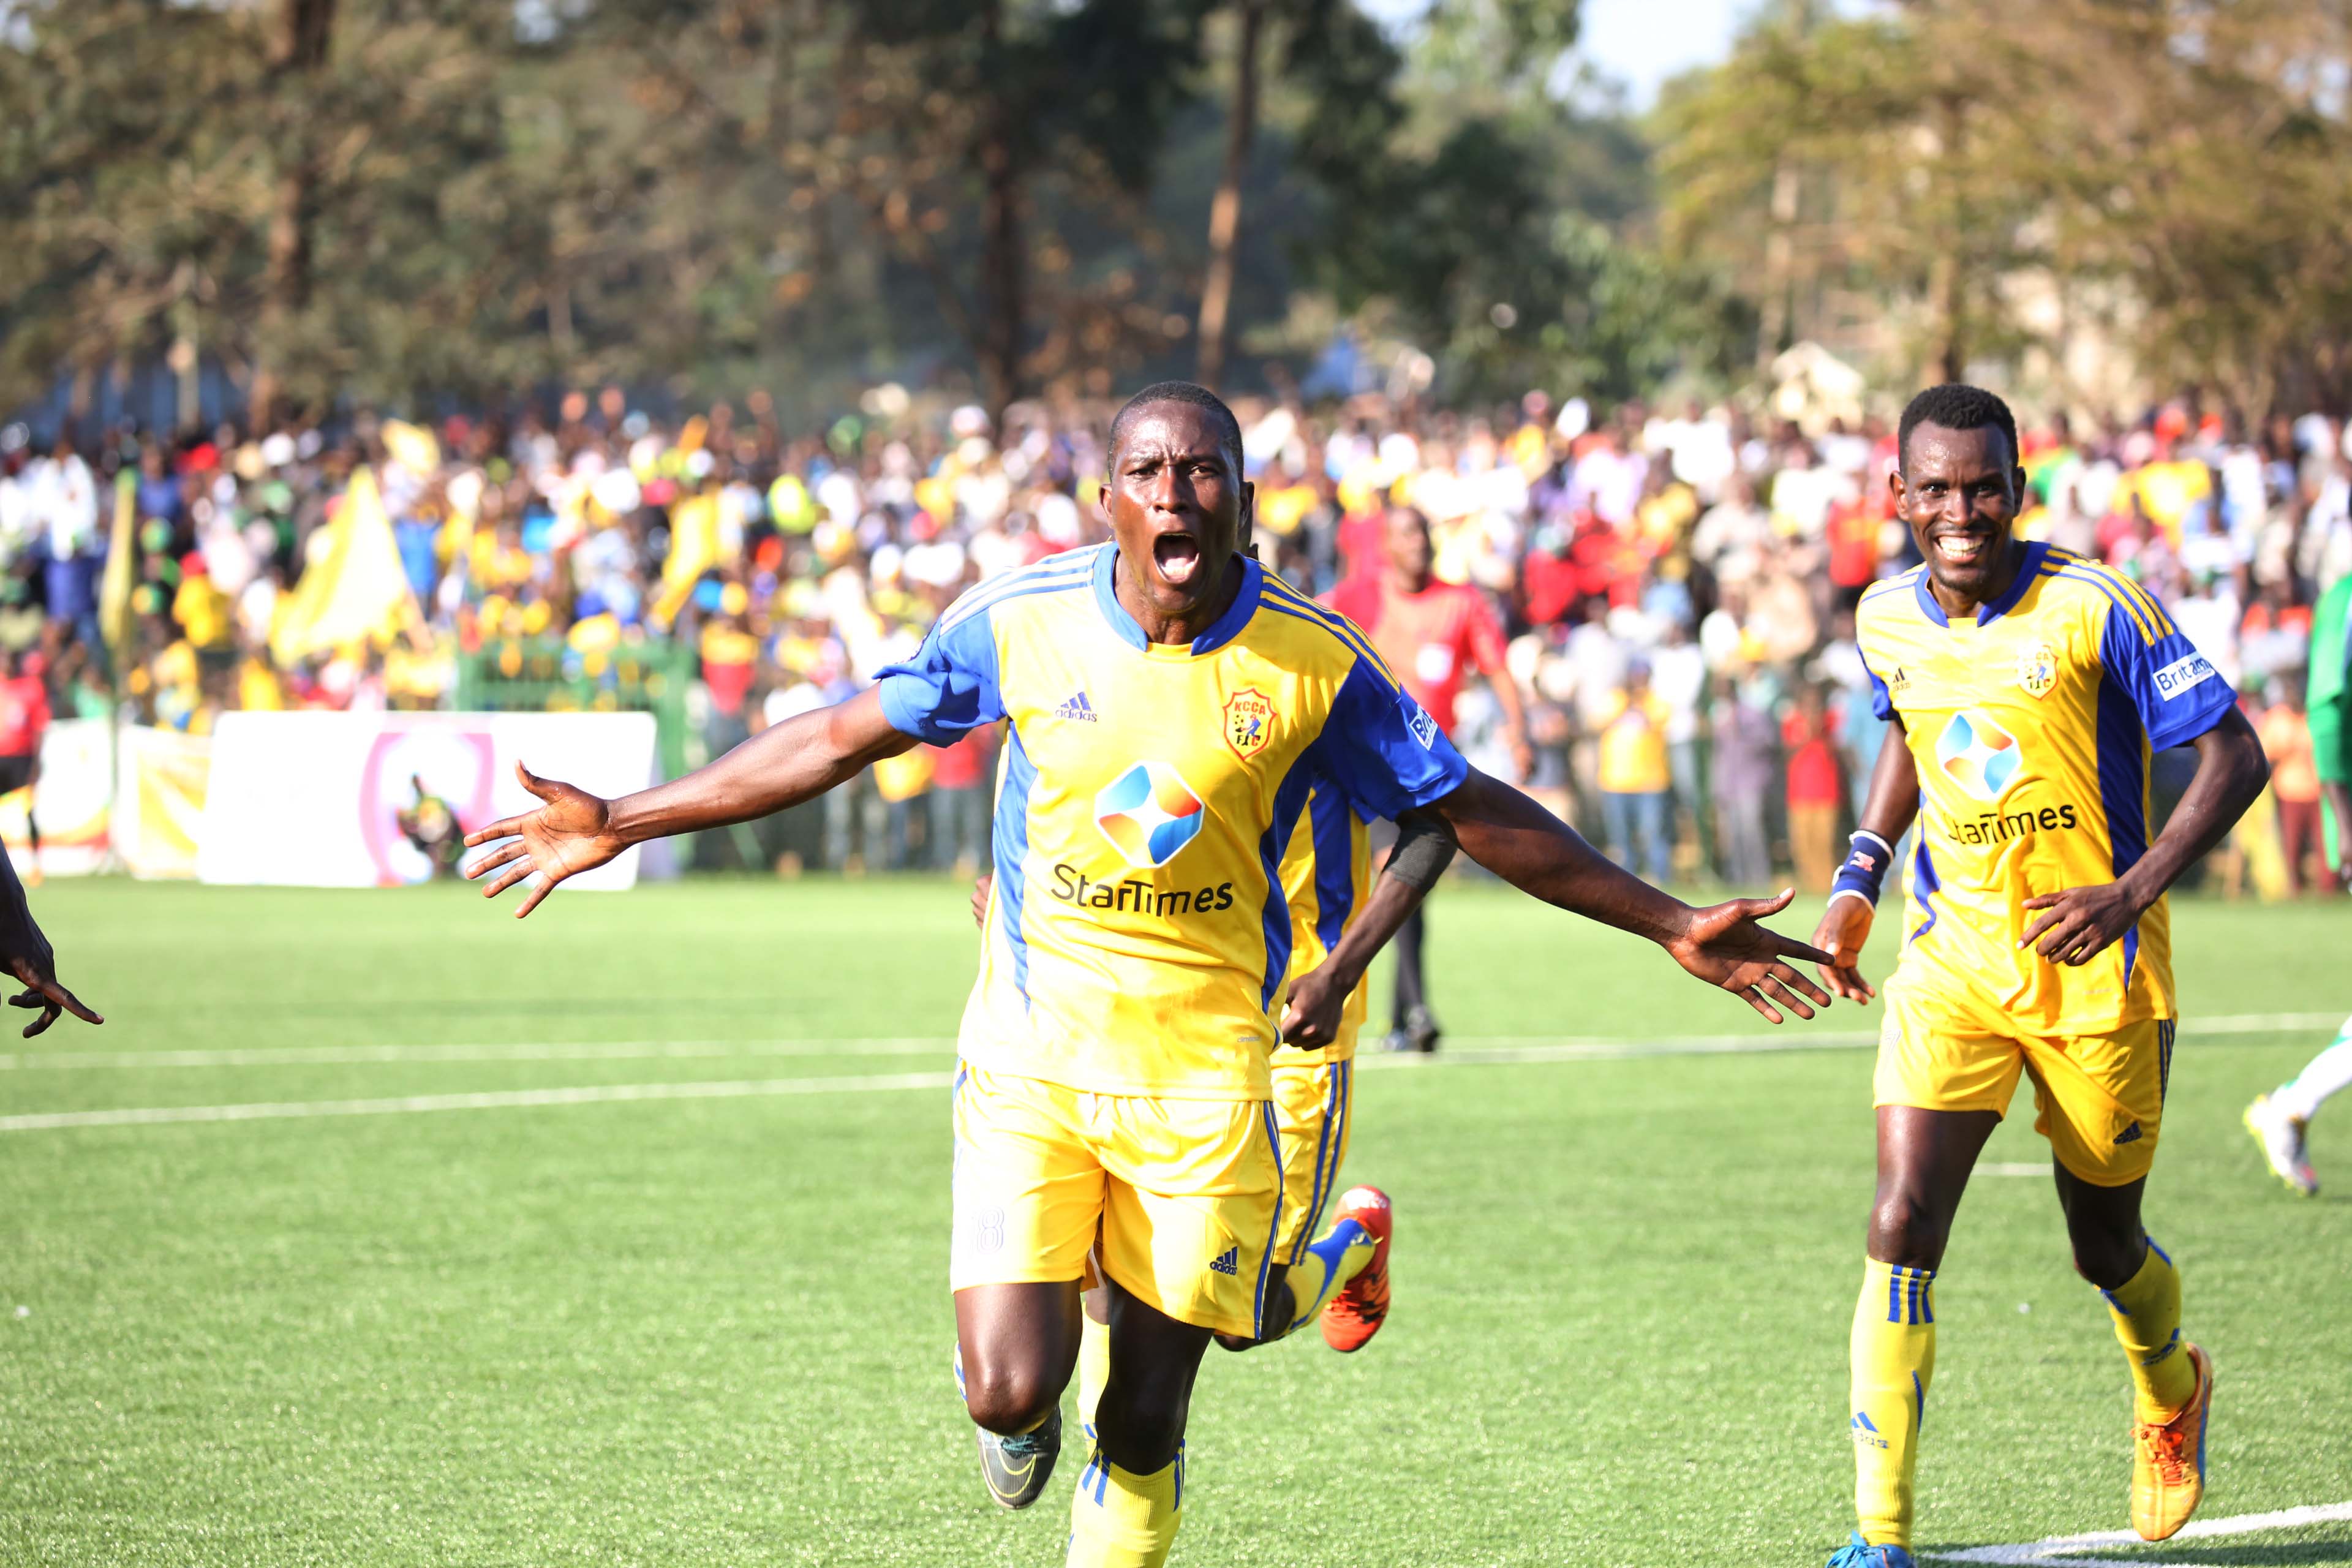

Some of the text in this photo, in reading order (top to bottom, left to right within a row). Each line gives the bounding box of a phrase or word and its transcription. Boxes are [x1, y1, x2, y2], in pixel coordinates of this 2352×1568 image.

[1234, 701, 1265, 715] KCCA
[1055, 709, 1098, 723] adidas
[1050, 864, 1233, 917] StarTimes
[1210, 1261, 1237, 1275] adidas
